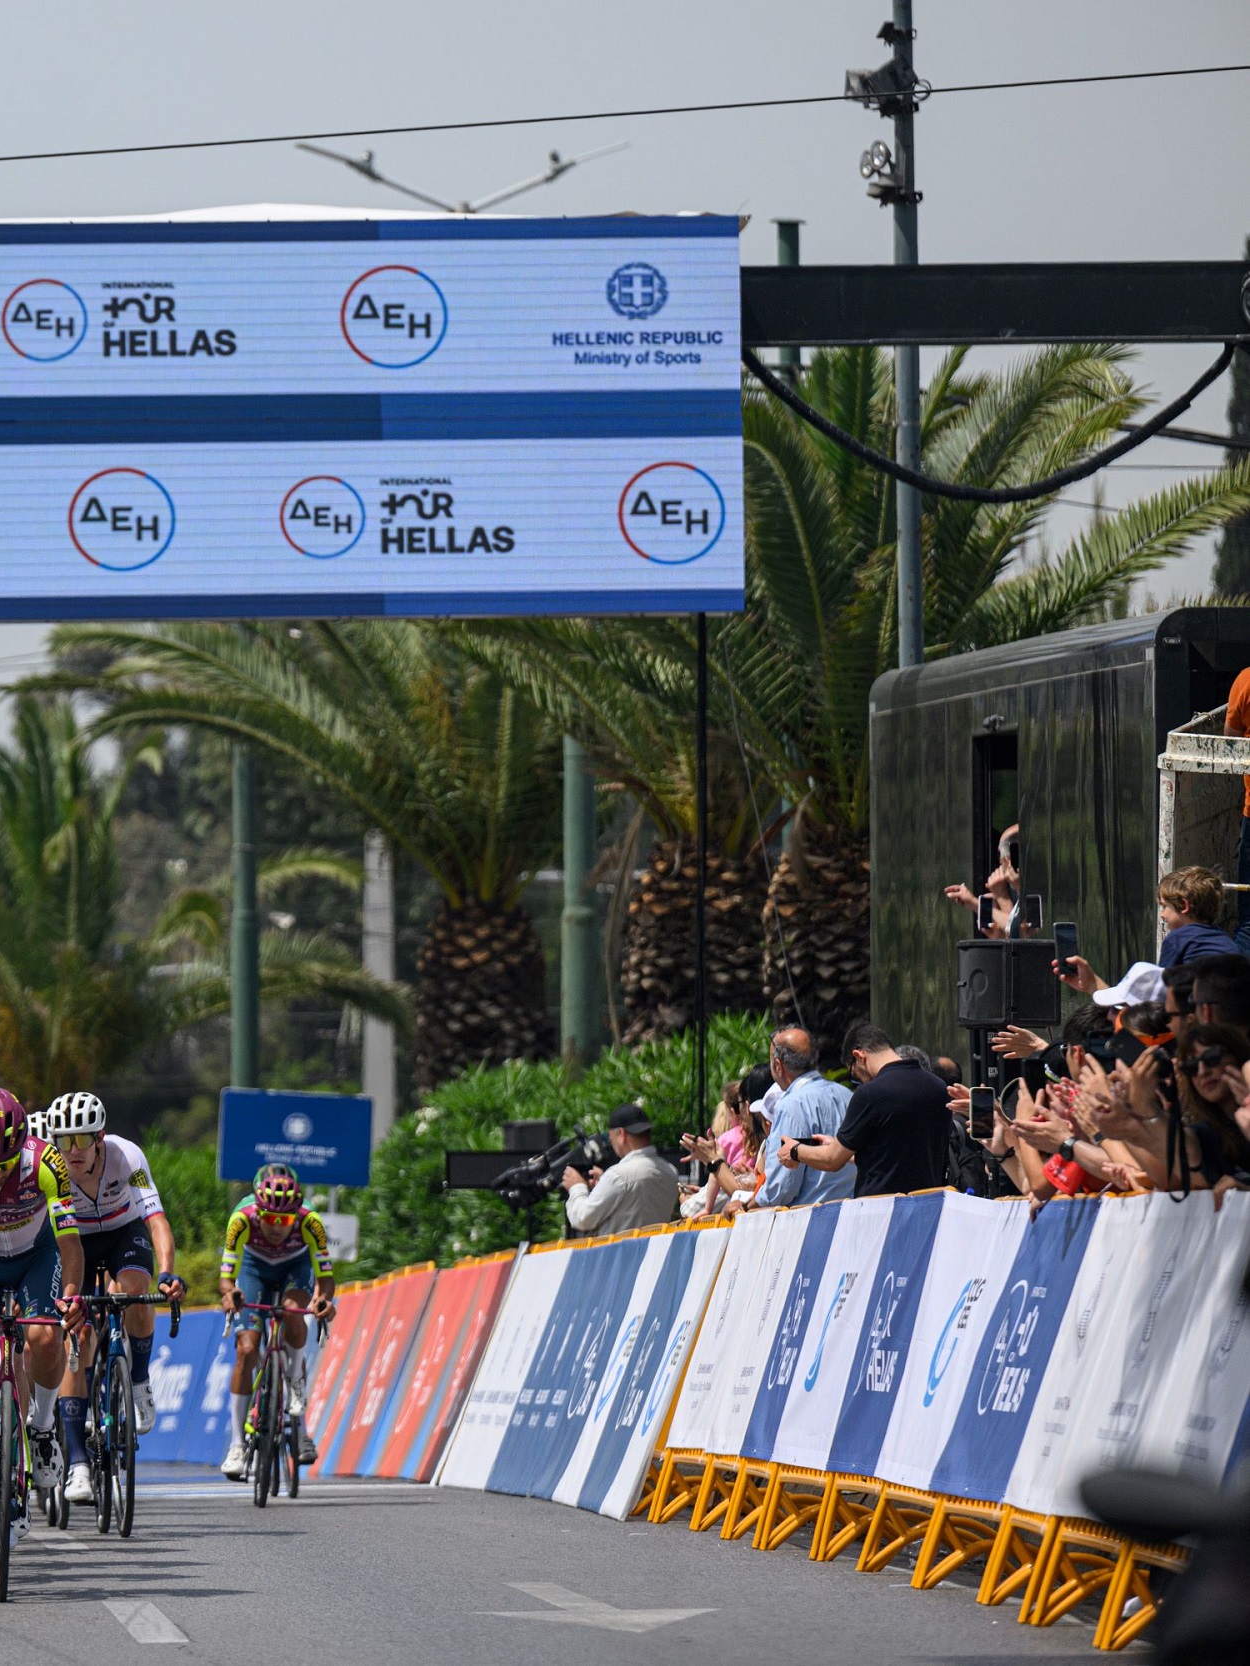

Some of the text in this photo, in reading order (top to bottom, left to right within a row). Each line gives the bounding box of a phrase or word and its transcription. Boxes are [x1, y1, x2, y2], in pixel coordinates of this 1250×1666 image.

[101, 281, 175, 290] INTERNATIONAL
[102, 329, 237, 358] HELLAS
[552, 331, 723, 345] HELLENIC REPUBLIC
[574, 351, 702, 367] Ministry of Sports
[379, 477, 452, 486] INTERNATIONAL
[380, 525, 516, 555] HELLAS
